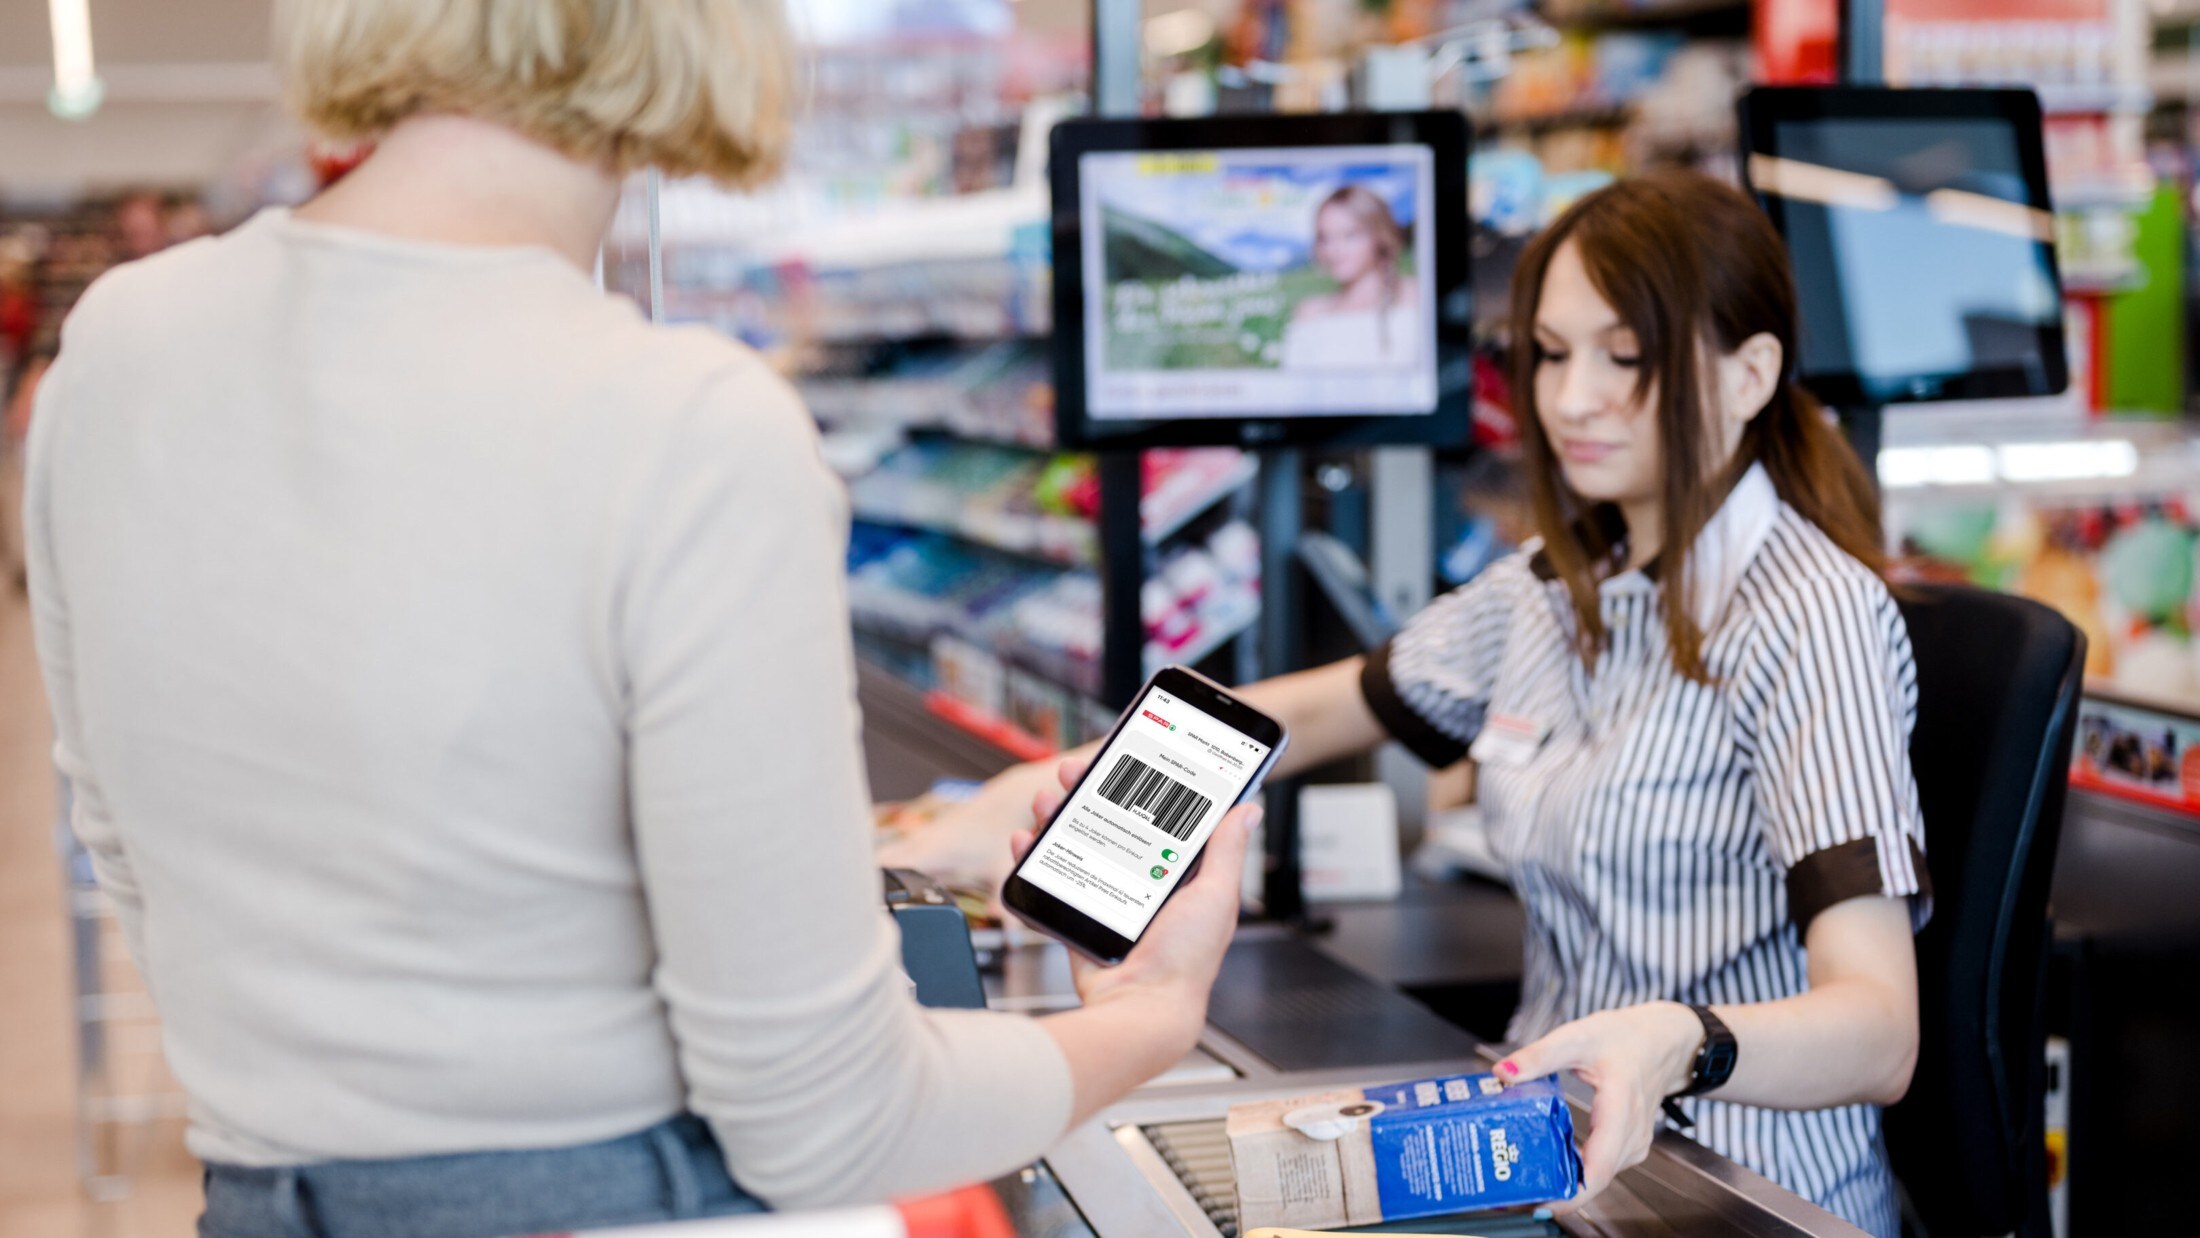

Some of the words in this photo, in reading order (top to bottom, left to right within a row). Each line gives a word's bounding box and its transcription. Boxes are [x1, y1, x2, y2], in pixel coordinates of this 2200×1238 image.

[1157, 694, 1171, 704] 11:43
[1146, 712, 1171, 728] SPAR
[1187, 731, 1199, 740] SPAR
[1158, 753, 1171, 763] Mein
[1170, 759, 1197, 777] SPAR-Code
[1068, 823, 1090, 838] eingelöst
[1088, 835, 1106, 848] werden.
[1081, 805, 1091, 813] Alle
[1090, 810, 1104, 820] Joker
[1103, 817, 1132, 836] automatisch
[1130, 833, 1153, 847] einlösen!
[1071, 817, 1080, 825] Bis
[1088, 827, 1102, 837] Joker
[1101, 834, 1118, 847] können
[1116, 843, 1127, 851] pro
[1125, 847, 1144, 860] Einkauf
[1052, 841, 1084, 862] Joker-Hinweis
[1038, 859, 1068, 878] automatisch
[1042, 854, 1085, 881] rabattberechtigten
[1083, 877, 1100, 889] Artikel
[1097, 885, 1110, 895] Ihres
[1046, 848, 1055, 856] Die
[1054, 854, 1068, 863] Joker
[1066, 861, 1091, 877] reduzieren
[1097, 877, 1119, 893] (maximal
[1489, 1128, 1511, 1182] REGIO
